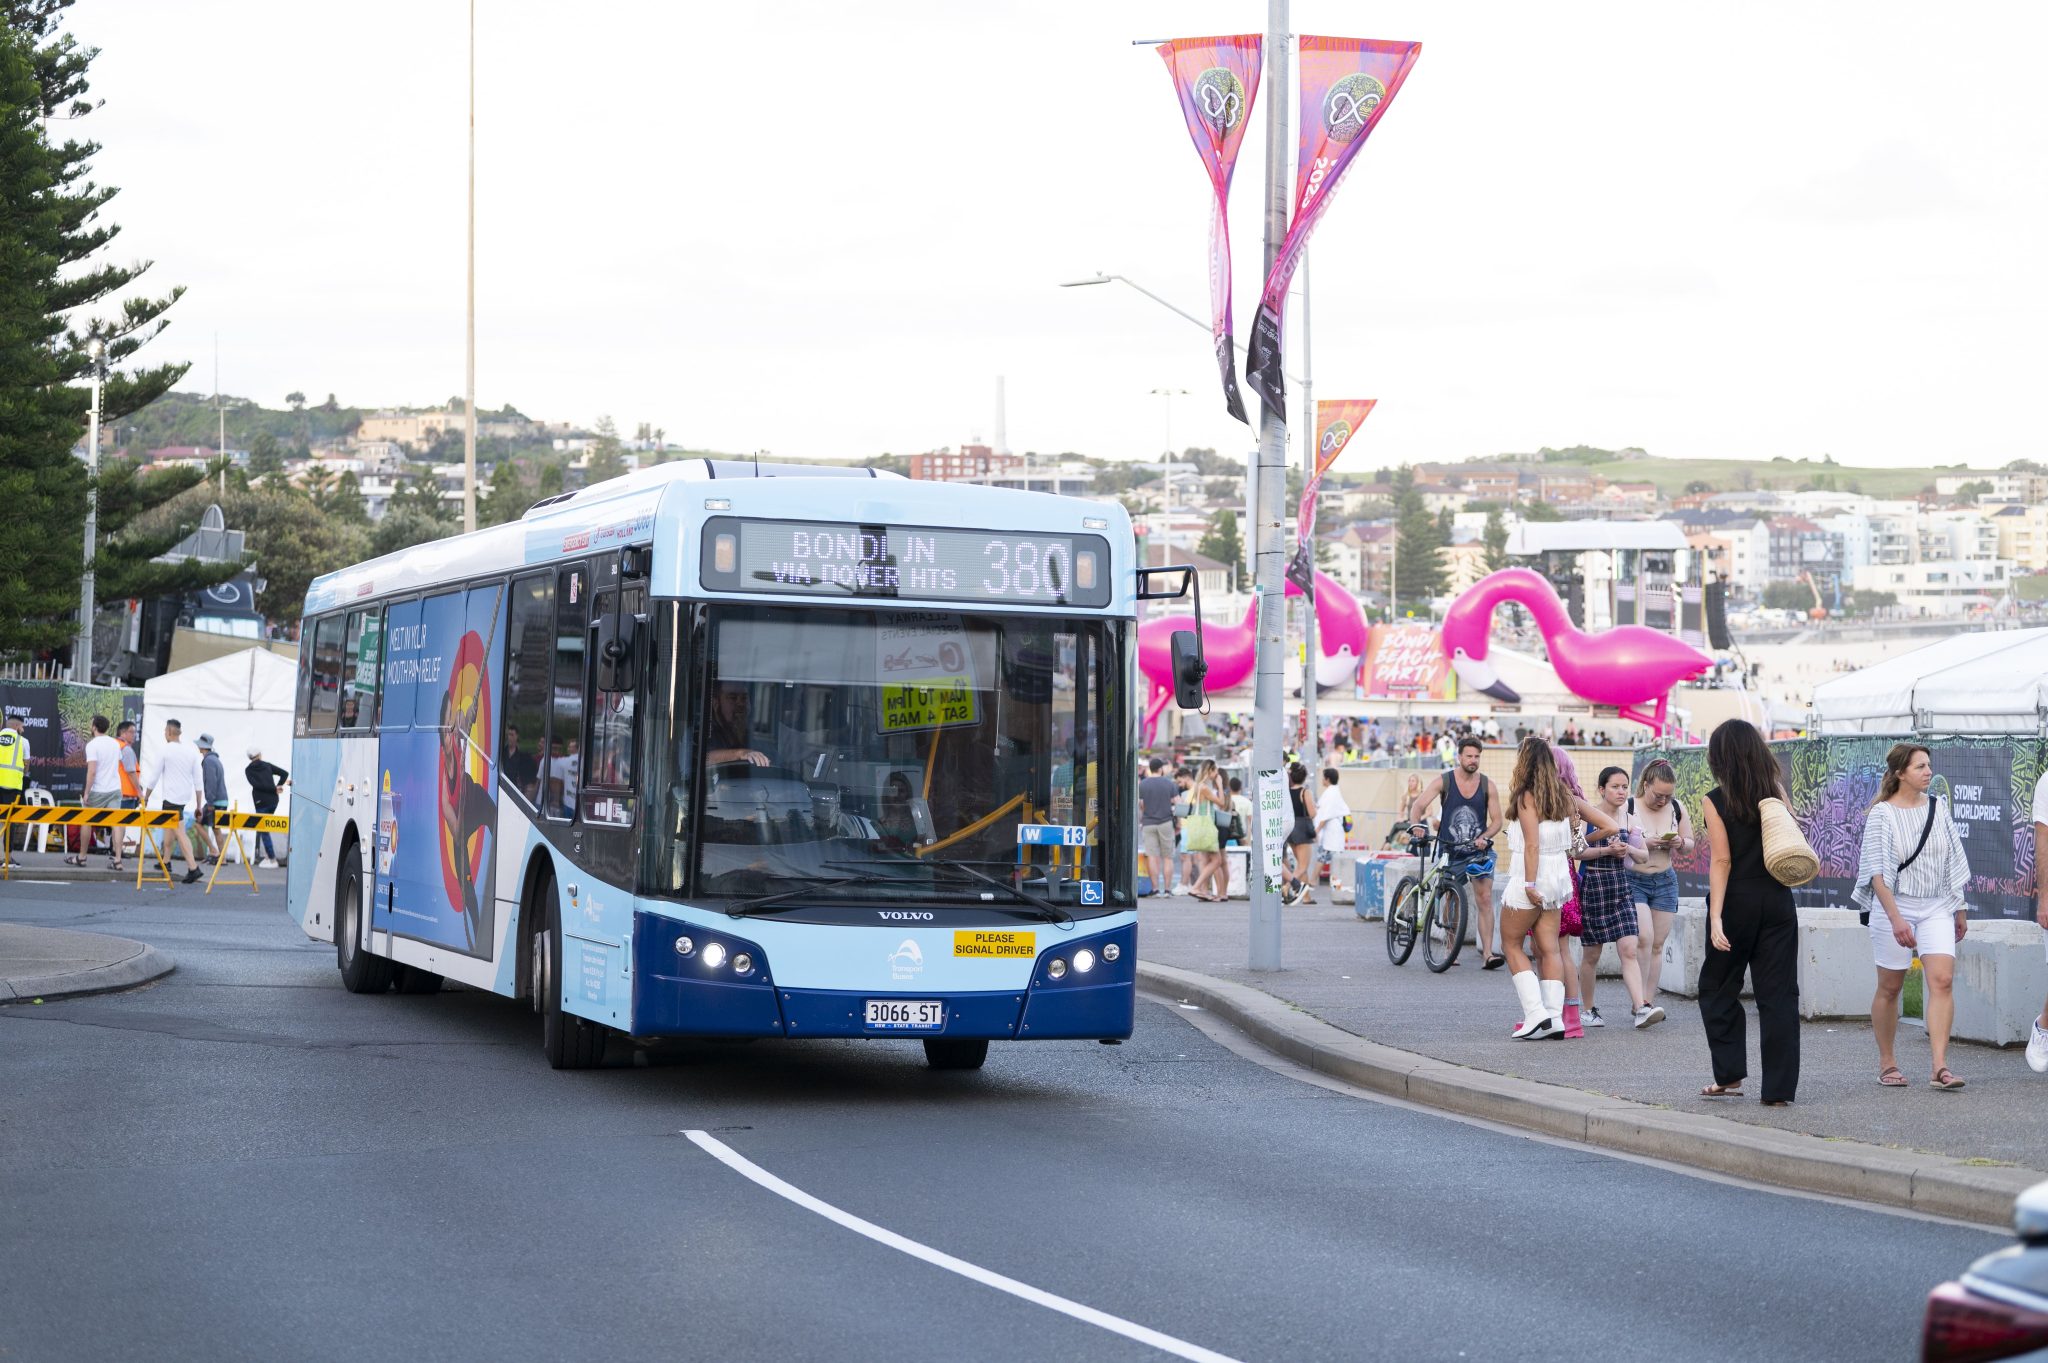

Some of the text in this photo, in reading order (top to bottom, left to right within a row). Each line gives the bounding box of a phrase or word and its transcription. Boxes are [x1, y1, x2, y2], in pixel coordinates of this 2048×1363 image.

[794, 532, 935, 563] BONDI JN
[772, 562, 956, 589] VIA DOVER HTS
[984, 541, 1069, 596] 380
[1382, 630, 1435, 649] BONDI
[1374, 649, 1443, 666] BEACH
[1375, 665, 1438, 683] PARTY
[5, 705, 31, 716] SYDNEY
[1954, 784, 1983, 801] SYDNEY
[1261, 801, 1282, 810] SANC
[1953, 803, 2001, 822] WORLDPRIDE
[265, 819, 287, 829] ROAD
[1025, 827, 1084, 844] W 13
[877, 911, 934, 920] VOLVO
[976, 934, 1014, 943] PLEASE
[955, 945, 1034, 955] SIGNAL DRIVER
